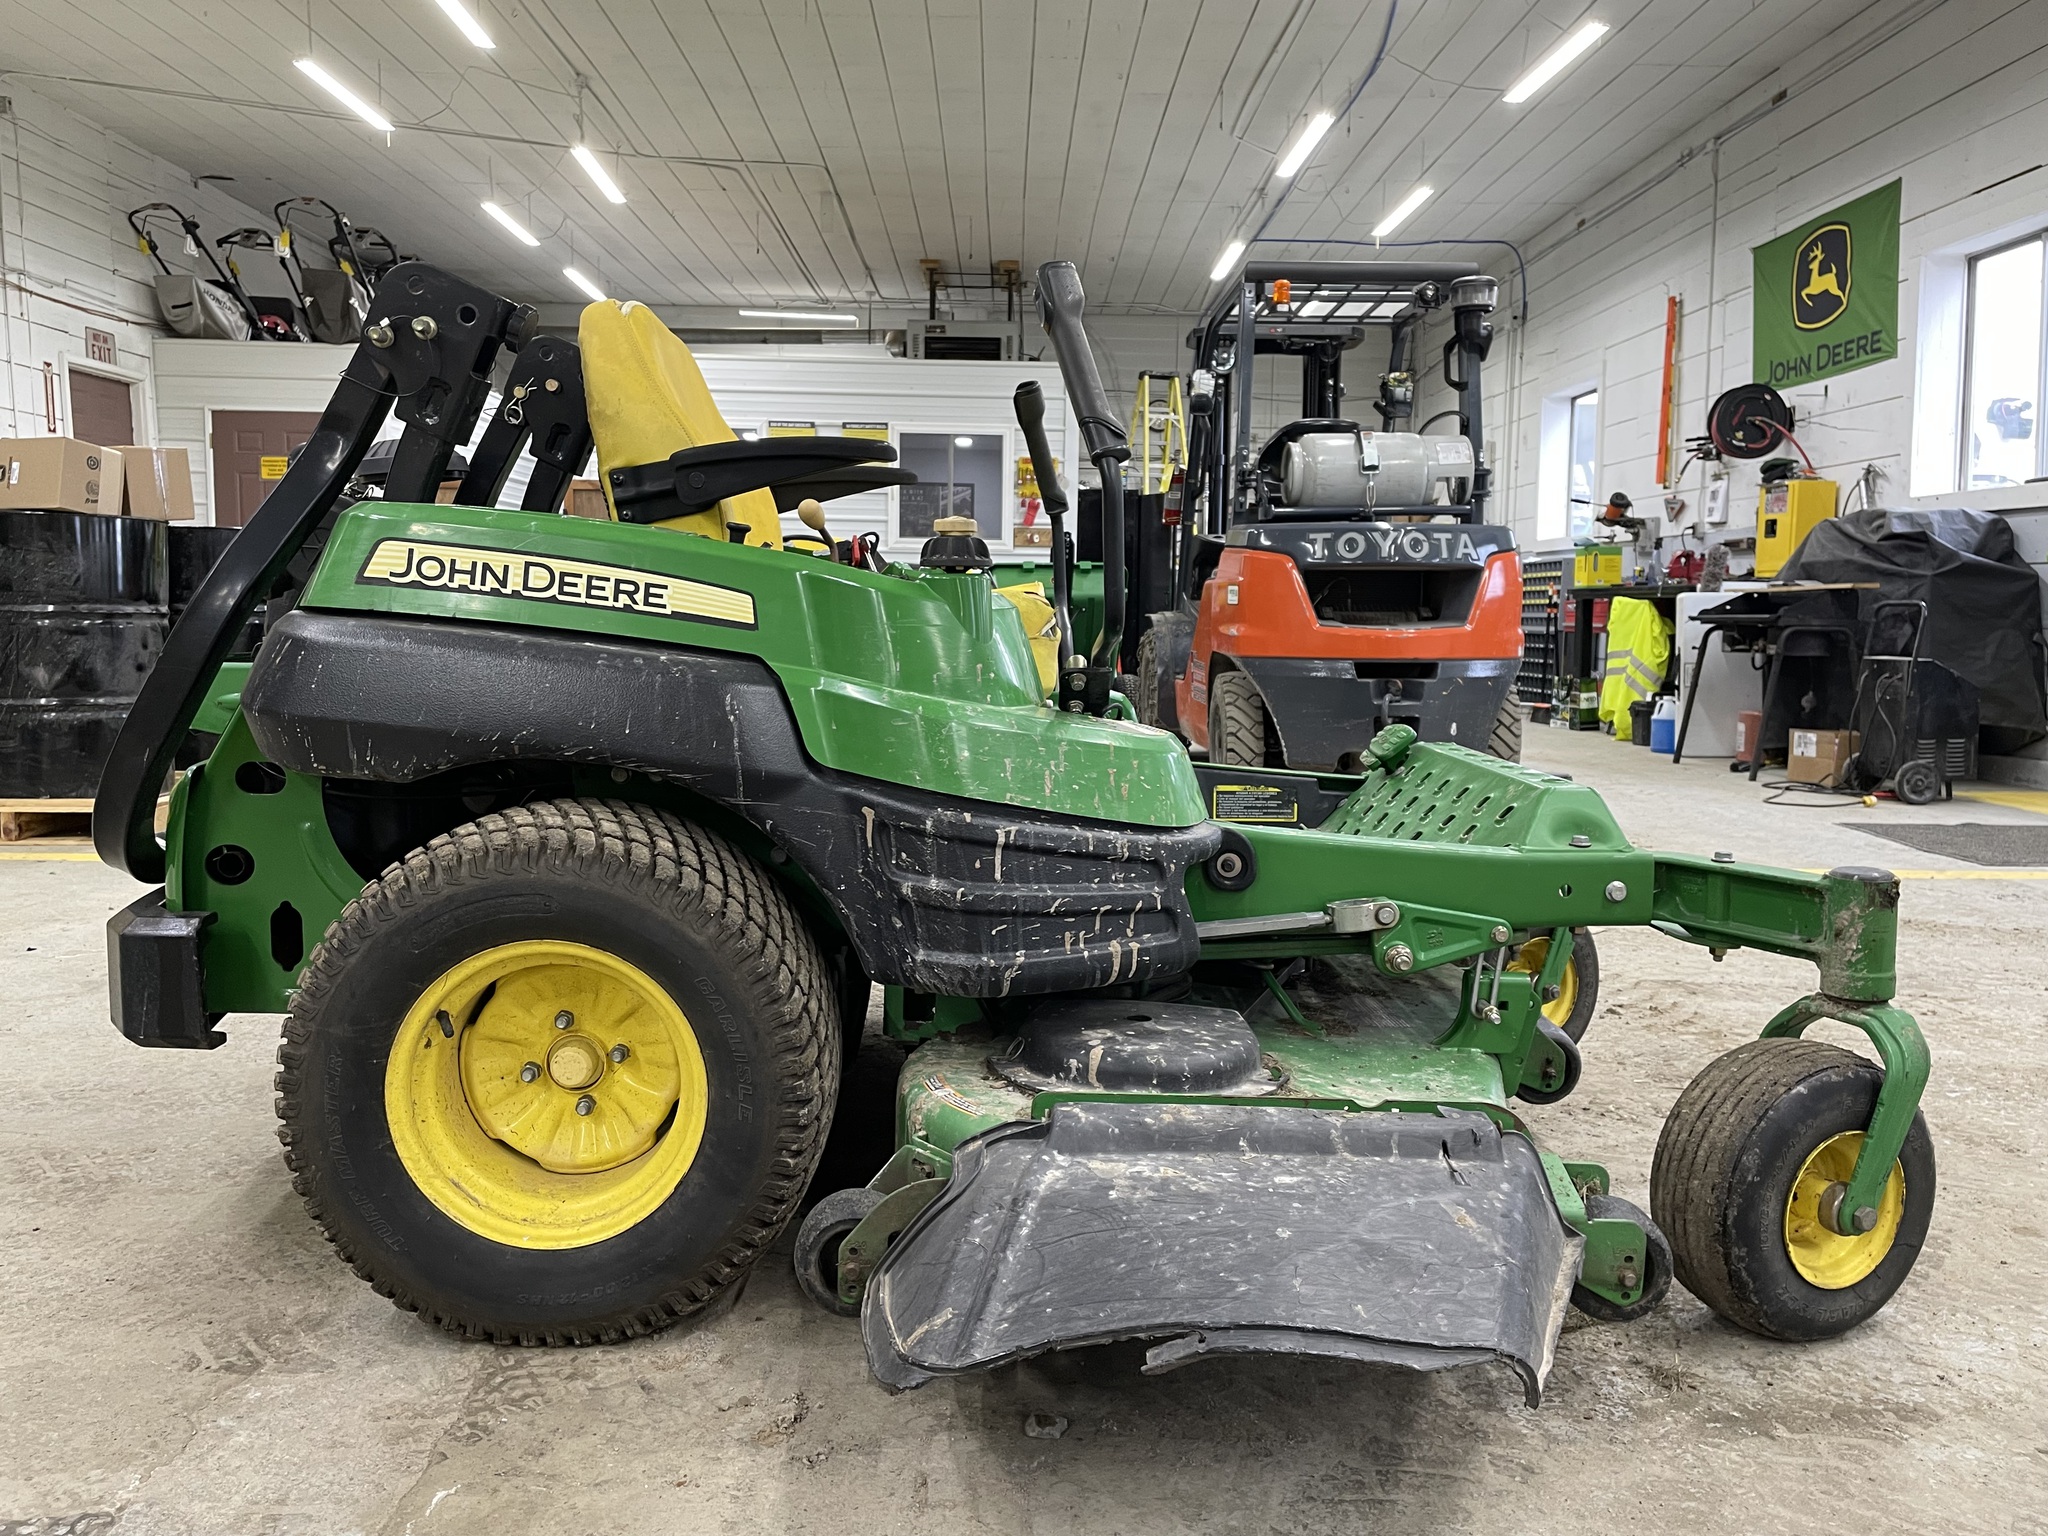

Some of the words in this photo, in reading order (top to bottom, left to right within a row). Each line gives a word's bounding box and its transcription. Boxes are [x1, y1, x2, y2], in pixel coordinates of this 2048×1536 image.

[202, 287, 235, 315] HONDA
[92, 343, 112, 365] EXIT
[1764, 354, 1813, 386] JOHN
[1816, 329, 1883, 372] DEERE
[1307, 531, 1480, 561] TOYOTA
[389, 547, 511, 592] JOHN
[523, 560, 669, 611] DEERE
[693, 976, 755, 1124] CARLISLE
[323, 1053, 357, 1180] MASTER
[347, 1190, 405, 1252] TURF
